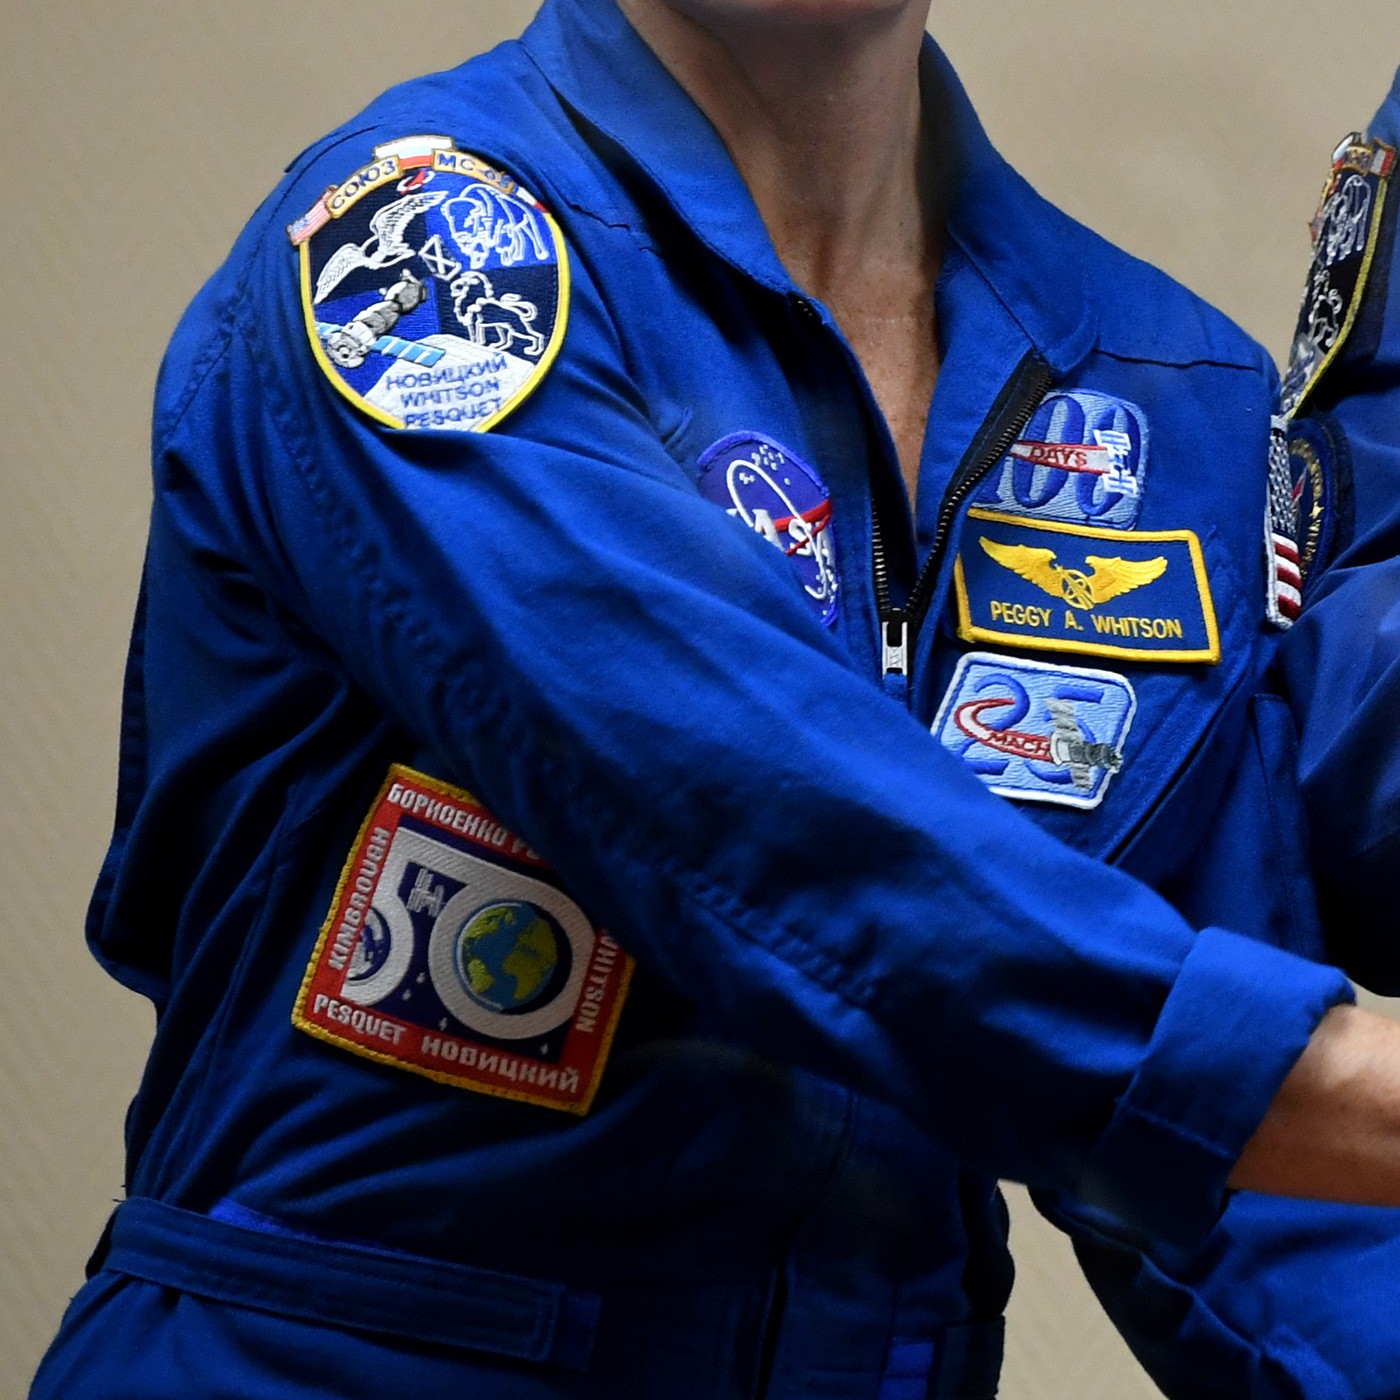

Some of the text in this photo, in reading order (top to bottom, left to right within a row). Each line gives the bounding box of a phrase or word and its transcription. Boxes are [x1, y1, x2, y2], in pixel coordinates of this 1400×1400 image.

[331, 160, 396, 209] СОЮЗ
[400, 377, 500, 408] WHITSON
[1030, 446, 1088, 467] DAYS
[726, 509, 834, 566] ASA
[990, 600, 1183, 639] PEGGY A. WHITSON
[990, 731, 1050, 758] MACH
[387, 783, 509, 846] БОРИСЕНКО
[328, 827, 391, 971] KIMBROUGH
[313, 994, 580, 1094] PESQUET НОВИЦКИЙ
